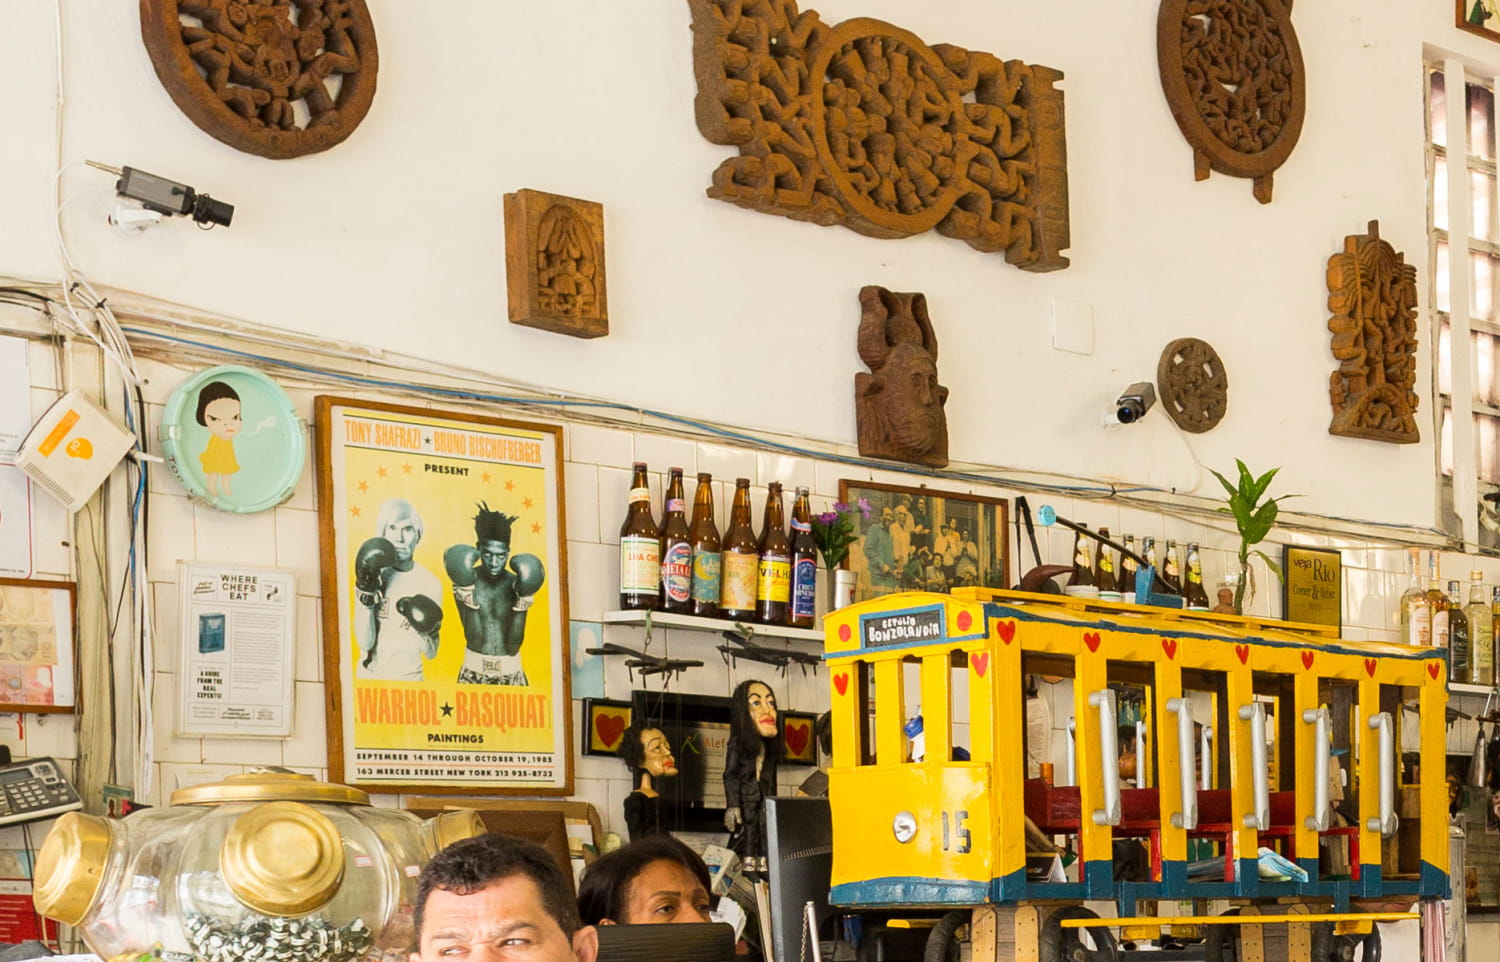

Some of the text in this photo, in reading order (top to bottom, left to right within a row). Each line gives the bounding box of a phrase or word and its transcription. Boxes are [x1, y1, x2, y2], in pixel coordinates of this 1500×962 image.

[344, 420, 542, 463] TONY SHAFRAZI BRUNO BISCHOFBERGER
[424, 463, 469, 476] PRESENT
[1313, 558, 1336, 583] Rio
[221, 574, 258, 584] WHERE
[222, 583, 256, 593] CHEFS
[229, 592, 248, 600] EAT
[357, 687, 547, 733] WARHOL BASQUIAT
[427, 733, 484, 744] PAINTINGS
[356, 753, 409, 761] SEPTEMBER
[427, 754, 471, 762] THROUGH
[475, 755, 514, 763] OCTOBER
[376, 768, 410, 776] MERCER
[447, 769, 465, 777] NEW
[469, 769, 492, 777] YORK
[942, 810, 972, 854] 15
